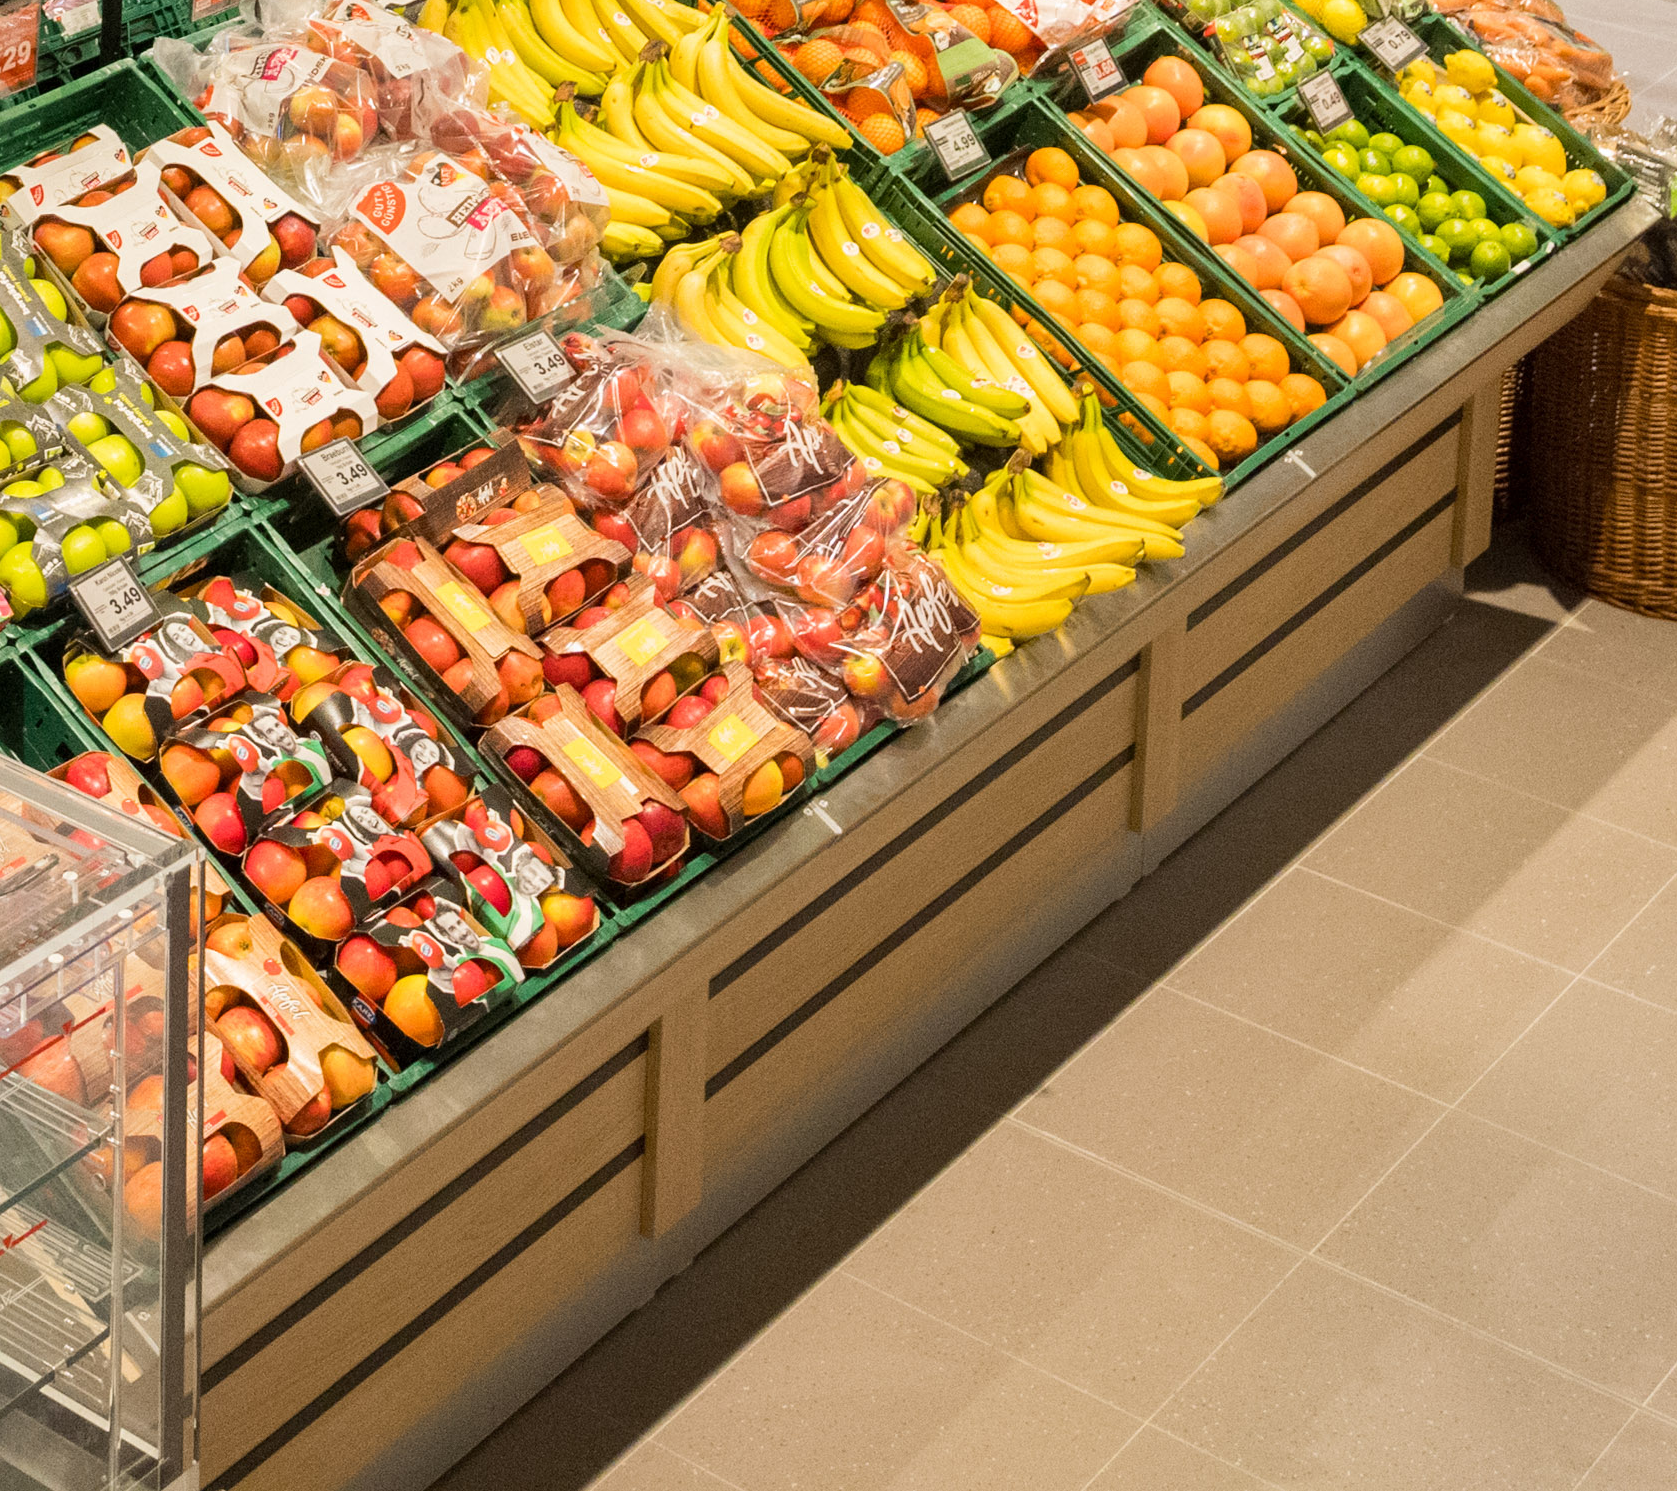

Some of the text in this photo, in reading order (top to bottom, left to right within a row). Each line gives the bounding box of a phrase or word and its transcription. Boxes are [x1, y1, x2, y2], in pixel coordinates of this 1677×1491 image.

[535, 354, 565, 376] 3.49
[336, 463, 368, 486] 3.49
[108, 586, 142, 615] 3.49
